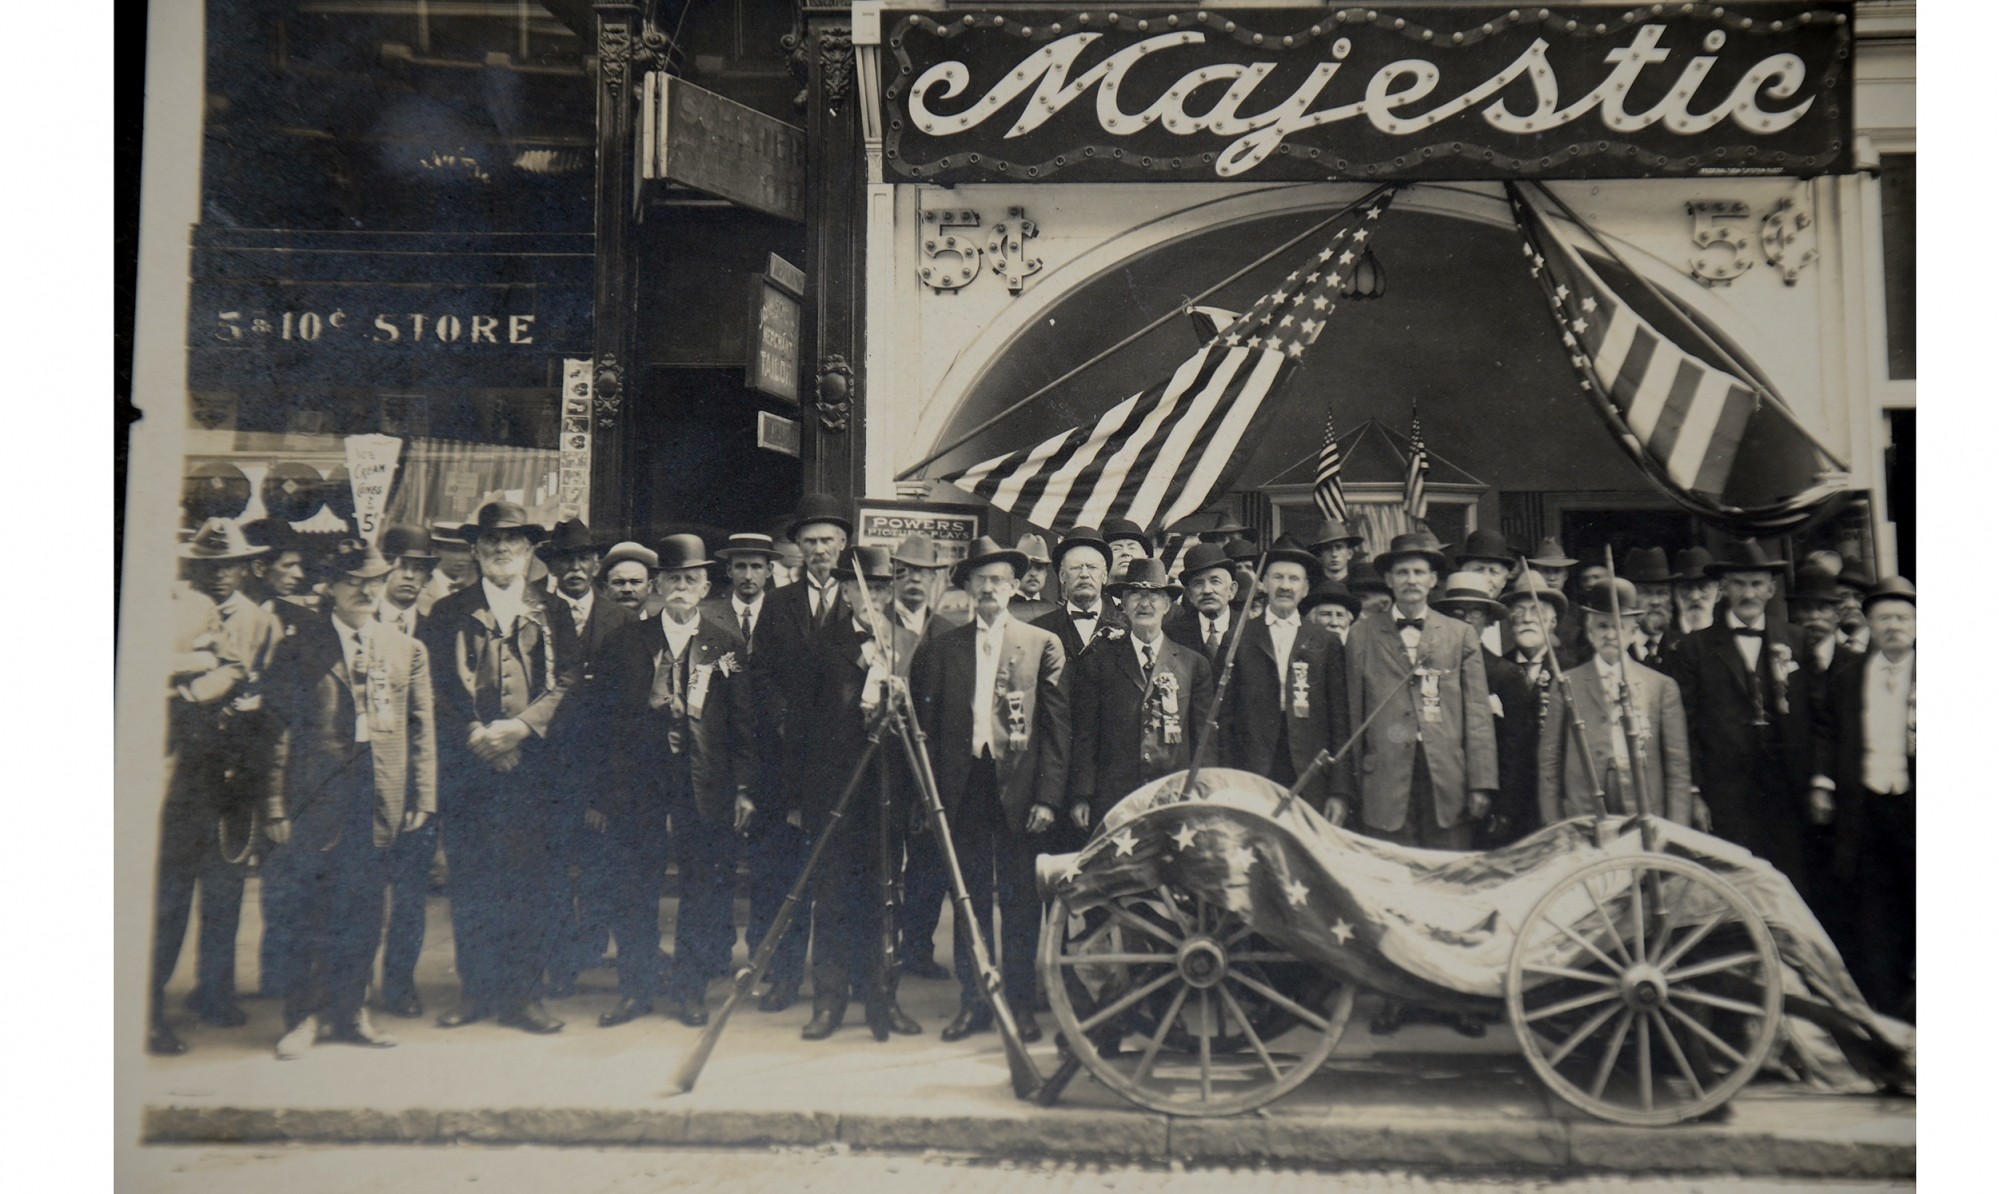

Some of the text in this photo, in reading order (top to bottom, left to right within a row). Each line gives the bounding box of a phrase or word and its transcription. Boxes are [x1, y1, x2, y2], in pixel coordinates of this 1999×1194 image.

[908, 23, 1815, 175] Majestic
[918, 206, 1043, 295] 5¢
[1685, 199, 1818, 287] 5¢
[373, 313, 536, 344] STORE
[354, 463, 385, 480] CREAM
[872, 517, 964, 531] POWERS
[930, 531, 969, 539] PLAYS
